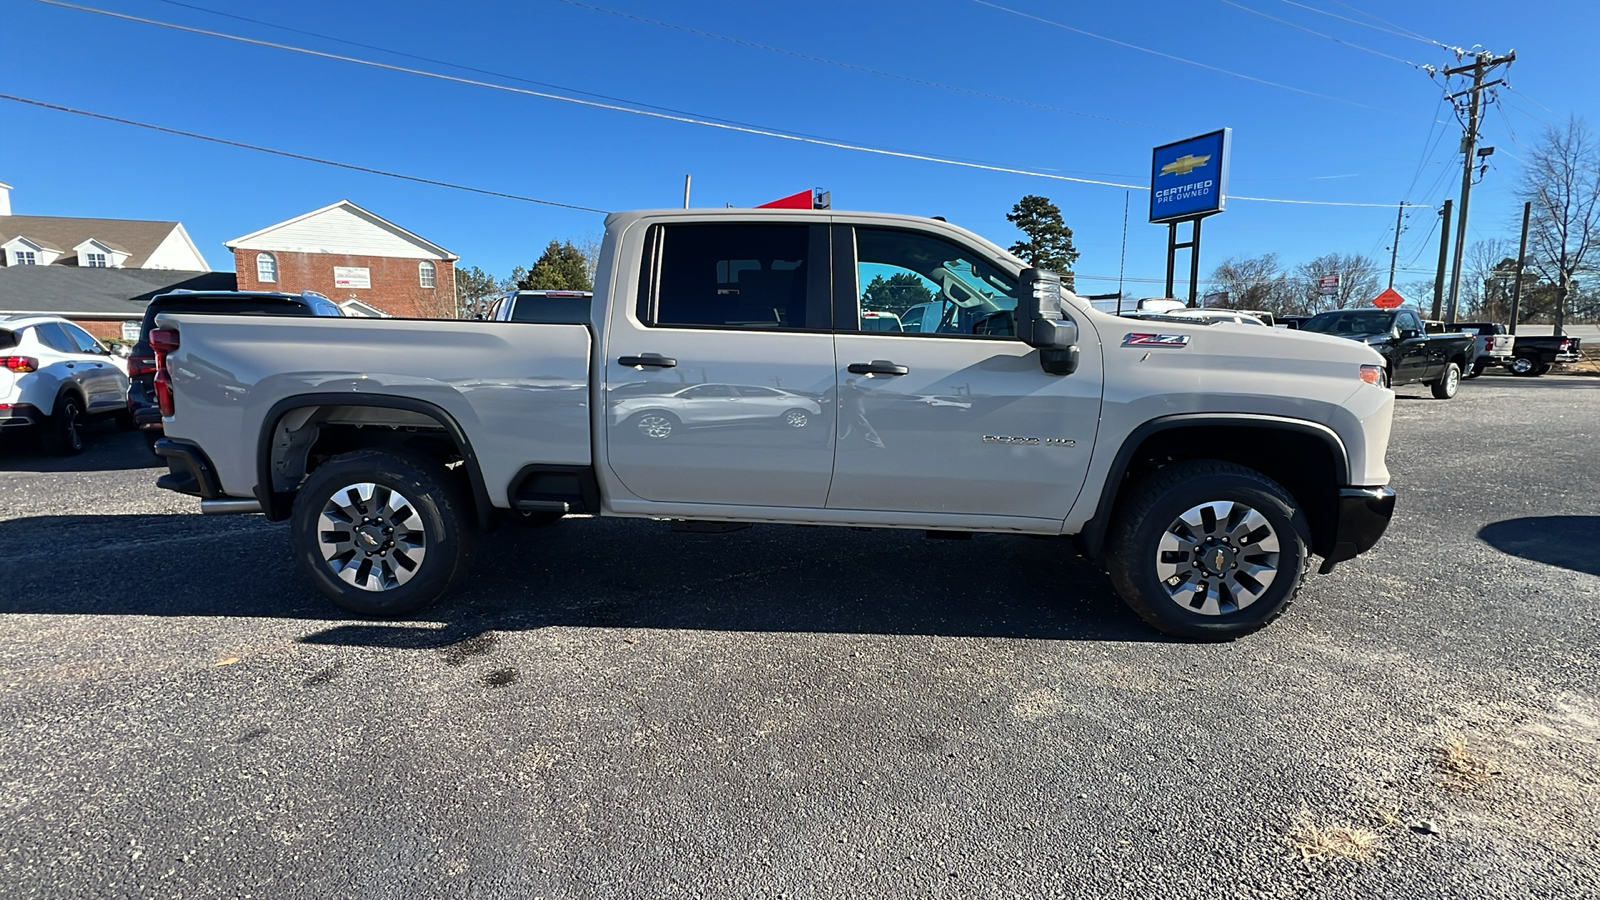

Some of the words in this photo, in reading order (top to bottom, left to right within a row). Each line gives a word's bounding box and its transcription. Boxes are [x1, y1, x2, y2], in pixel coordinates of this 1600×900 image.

[1155, 179, 1213, 198] CERTIFIED
[1157, 187, 1210, 204] PRE-OWNED
[1127, 332, 1191, 346] Z71
